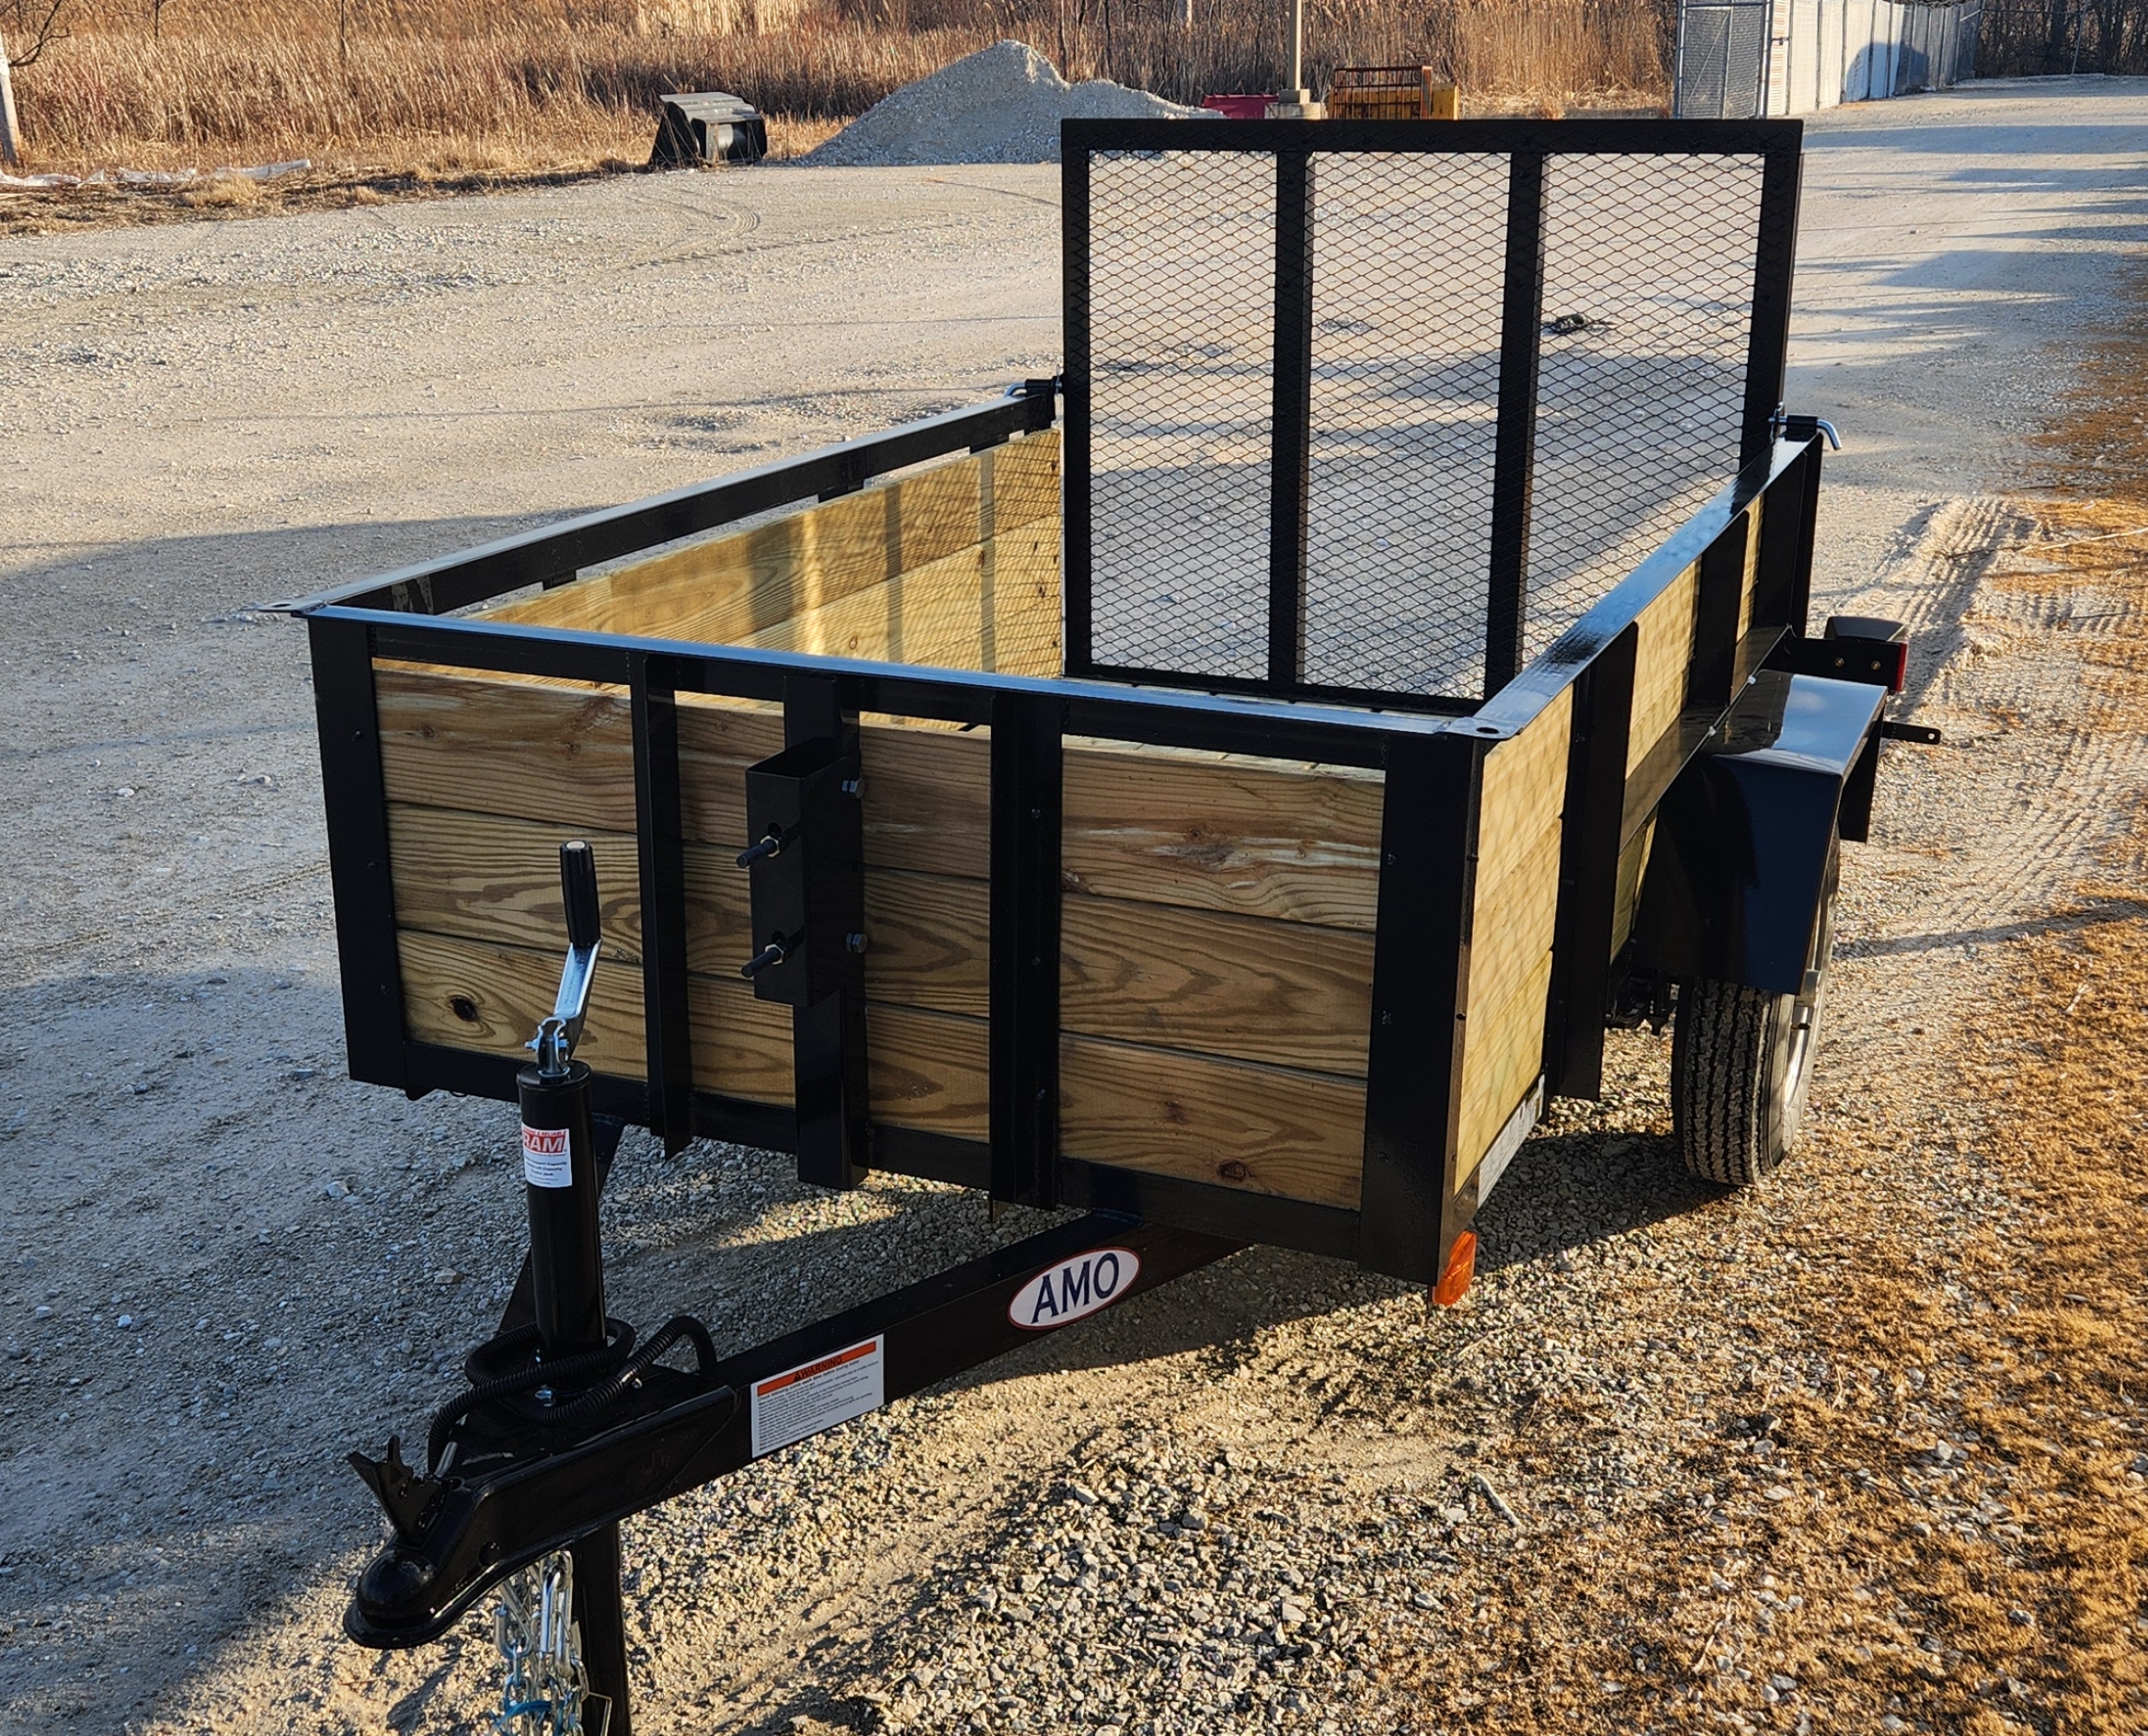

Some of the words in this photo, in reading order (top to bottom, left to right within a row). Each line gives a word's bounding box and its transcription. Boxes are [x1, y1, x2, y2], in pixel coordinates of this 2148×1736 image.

[523, 1132, 563, 1152] RAM
[1030, 1253, 1120, 1325] AMO
[801, 1357, 842, 1378] WARNING
